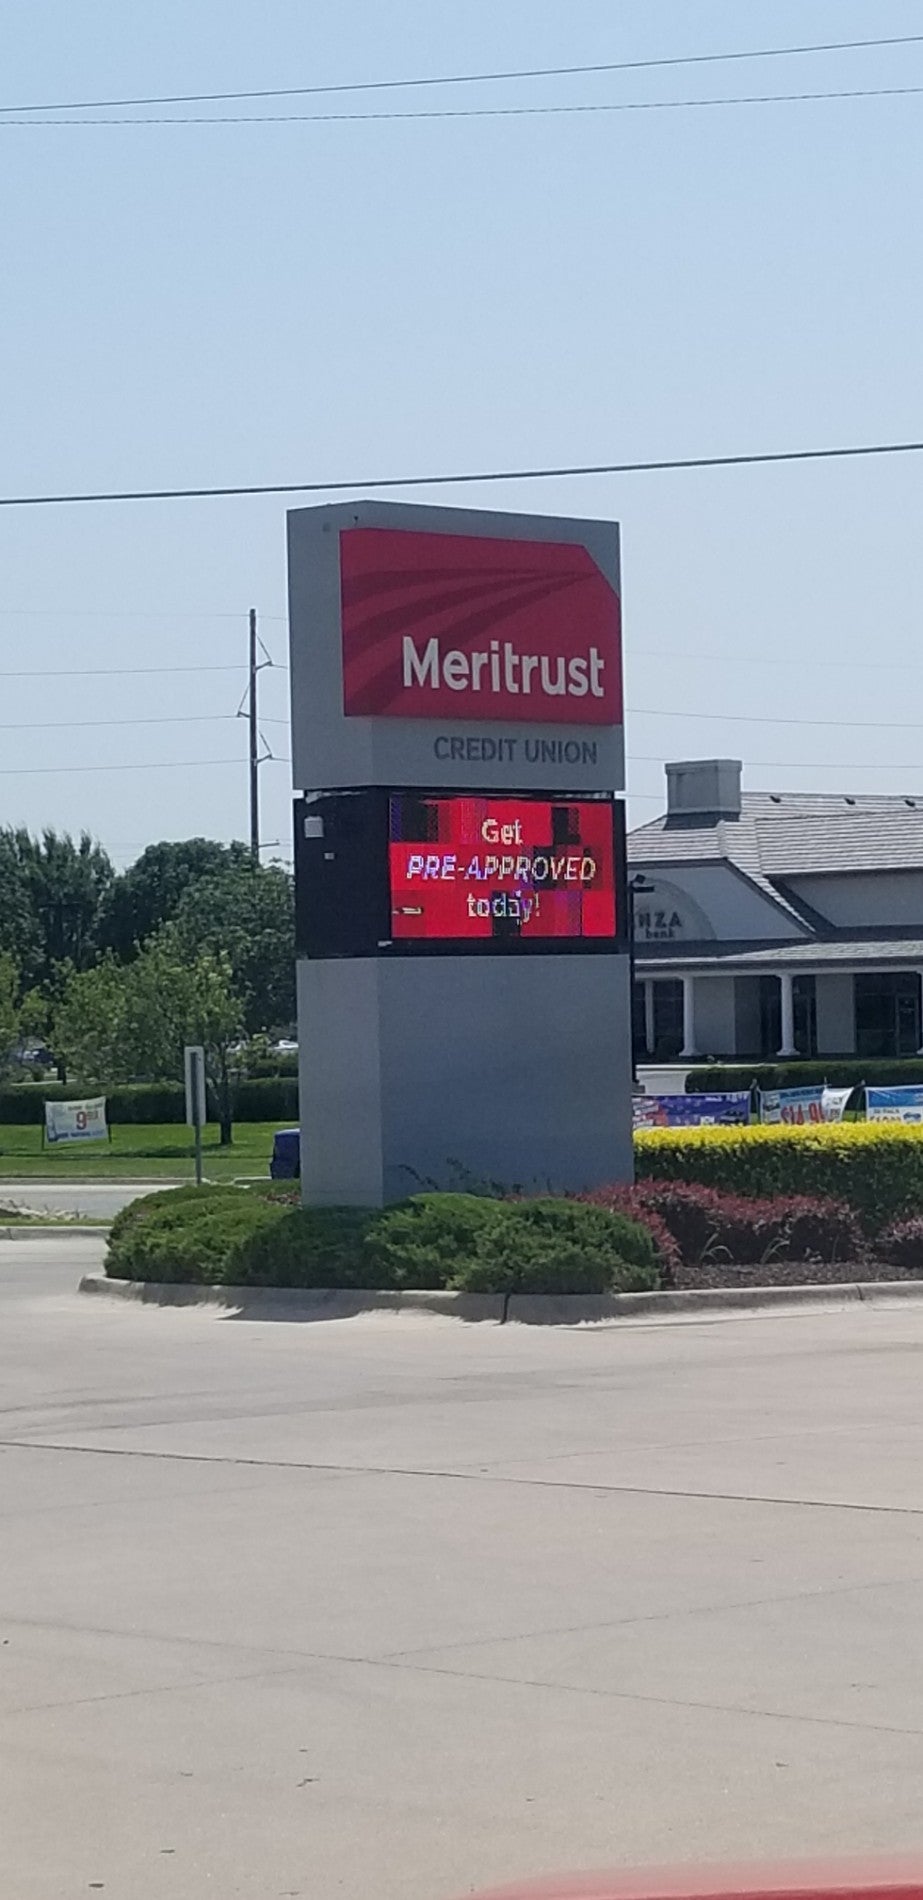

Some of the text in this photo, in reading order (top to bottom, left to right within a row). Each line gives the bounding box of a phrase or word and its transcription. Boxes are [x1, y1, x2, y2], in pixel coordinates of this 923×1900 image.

[402, 636, 604, 697] Meritrust
[433, 736, 598, 765] CREDIT UNION
[482, 818, 523, 845] Get
[406, 855, 597, 882] PRE-APPROVED
[467, 889, 540, 925] today!
